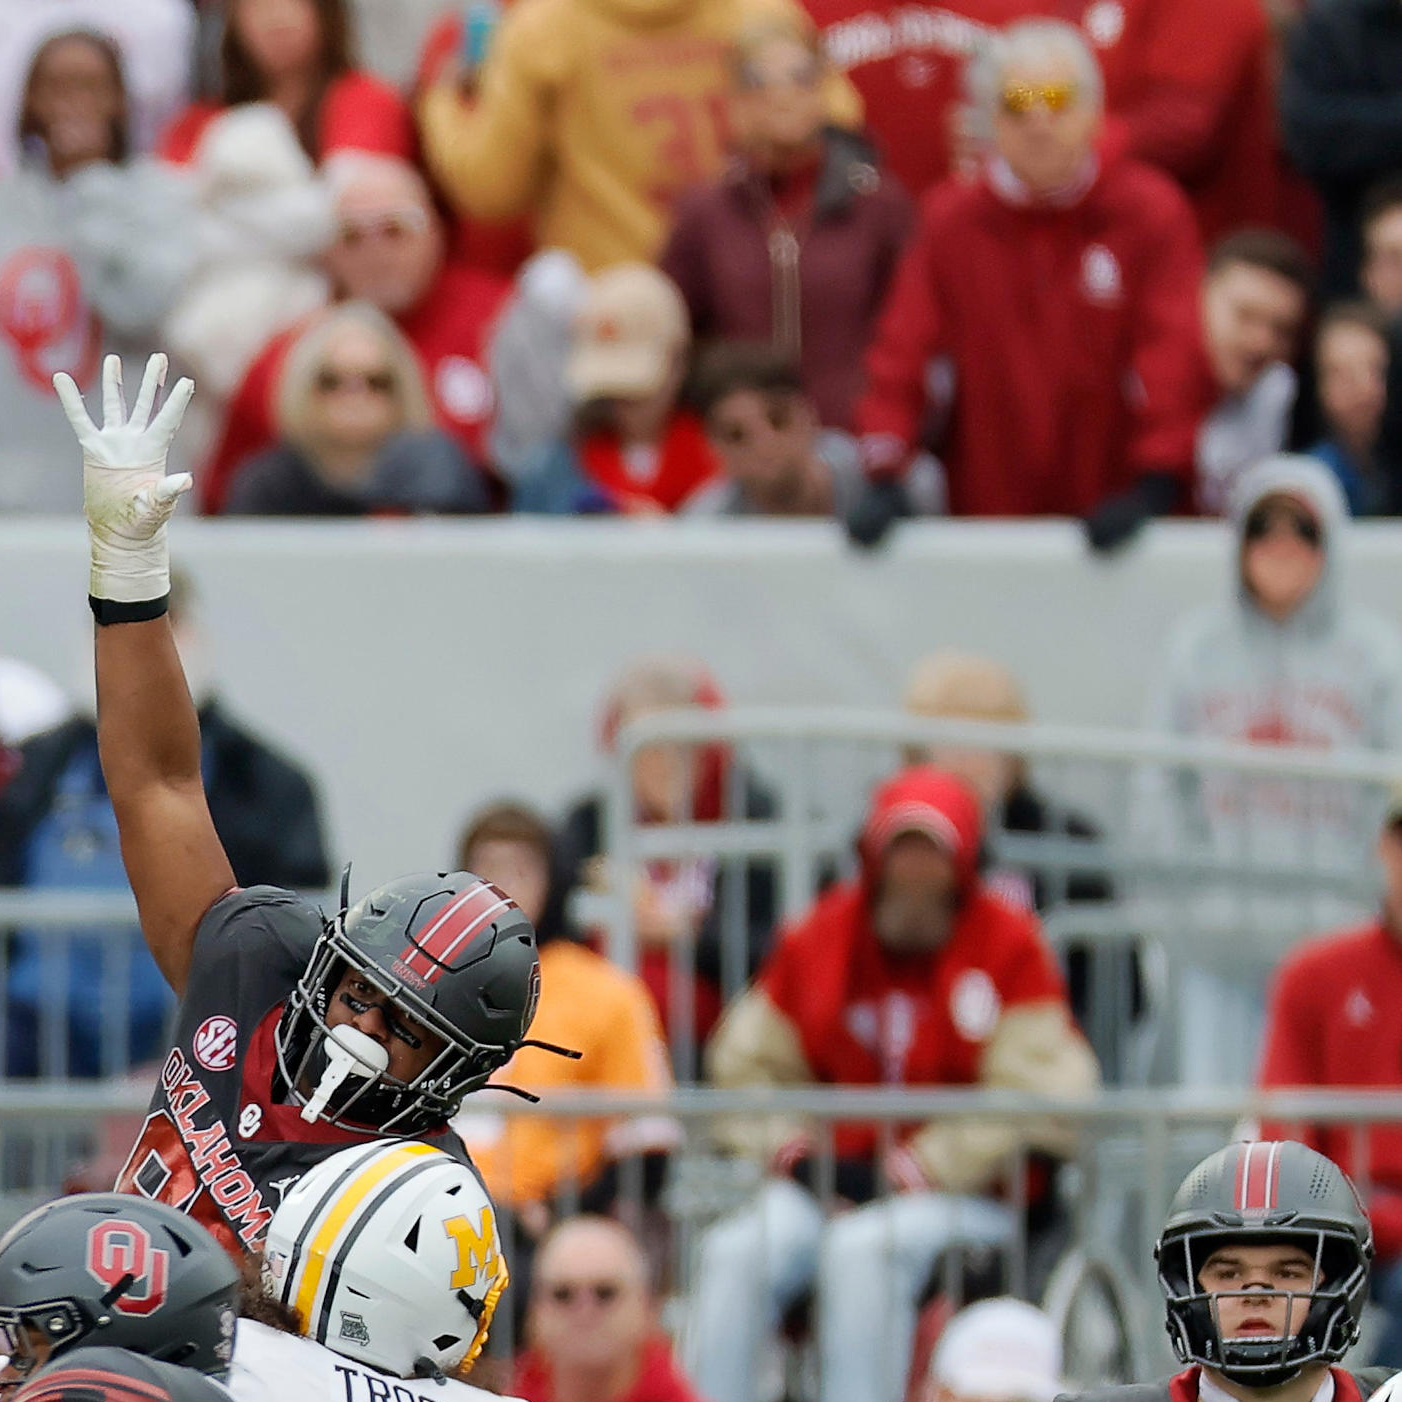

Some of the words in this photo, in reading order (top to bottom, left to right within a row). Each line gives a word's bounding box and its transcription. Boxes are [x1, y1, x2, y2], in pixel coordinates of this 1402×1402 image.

[162, 1046, 274, 1255] OKLAHOM
[86, 1218, 170, 1318] OU
[443, 1205, 500, 1290] M
